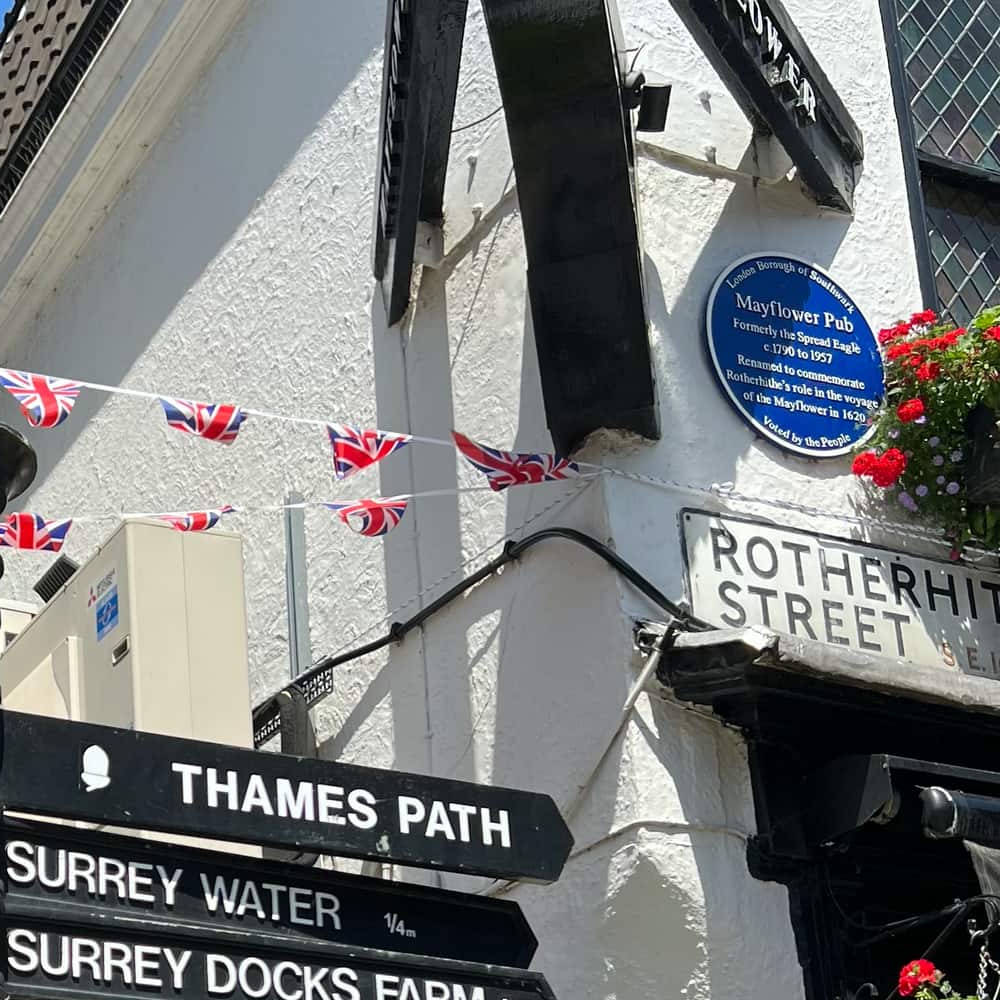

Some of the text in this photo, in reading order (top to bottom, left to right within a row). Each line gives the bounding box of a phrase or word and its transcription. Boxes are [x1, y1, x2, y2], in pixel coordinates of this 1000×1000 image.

[726, 260, 855, 314] London Borough of Southwark
[735, 292, 854, 333] Mayflower Pub
[733, 318, 861, 355] Formerly the Spread Eagle
[797, 348, 809, 359] to
[810, 350, 833, 364] 1957
[726, 369, 879, 411] Rotherhithe's role in the voyage
[737, 354, 865, 390] Renamed to commemorate
[743, 391, 866, 423] of the Mayflower in 1620
[763, 415, 851, 448] Voted by the People
[717, 580, 911, 657] STREET
[171, 762, 512, 848] THAMES PATH
[6, 840, 184, 906] SURREY
[200, 872, 342, 930] WATER
[7, 929, 192, 990] SURREY
